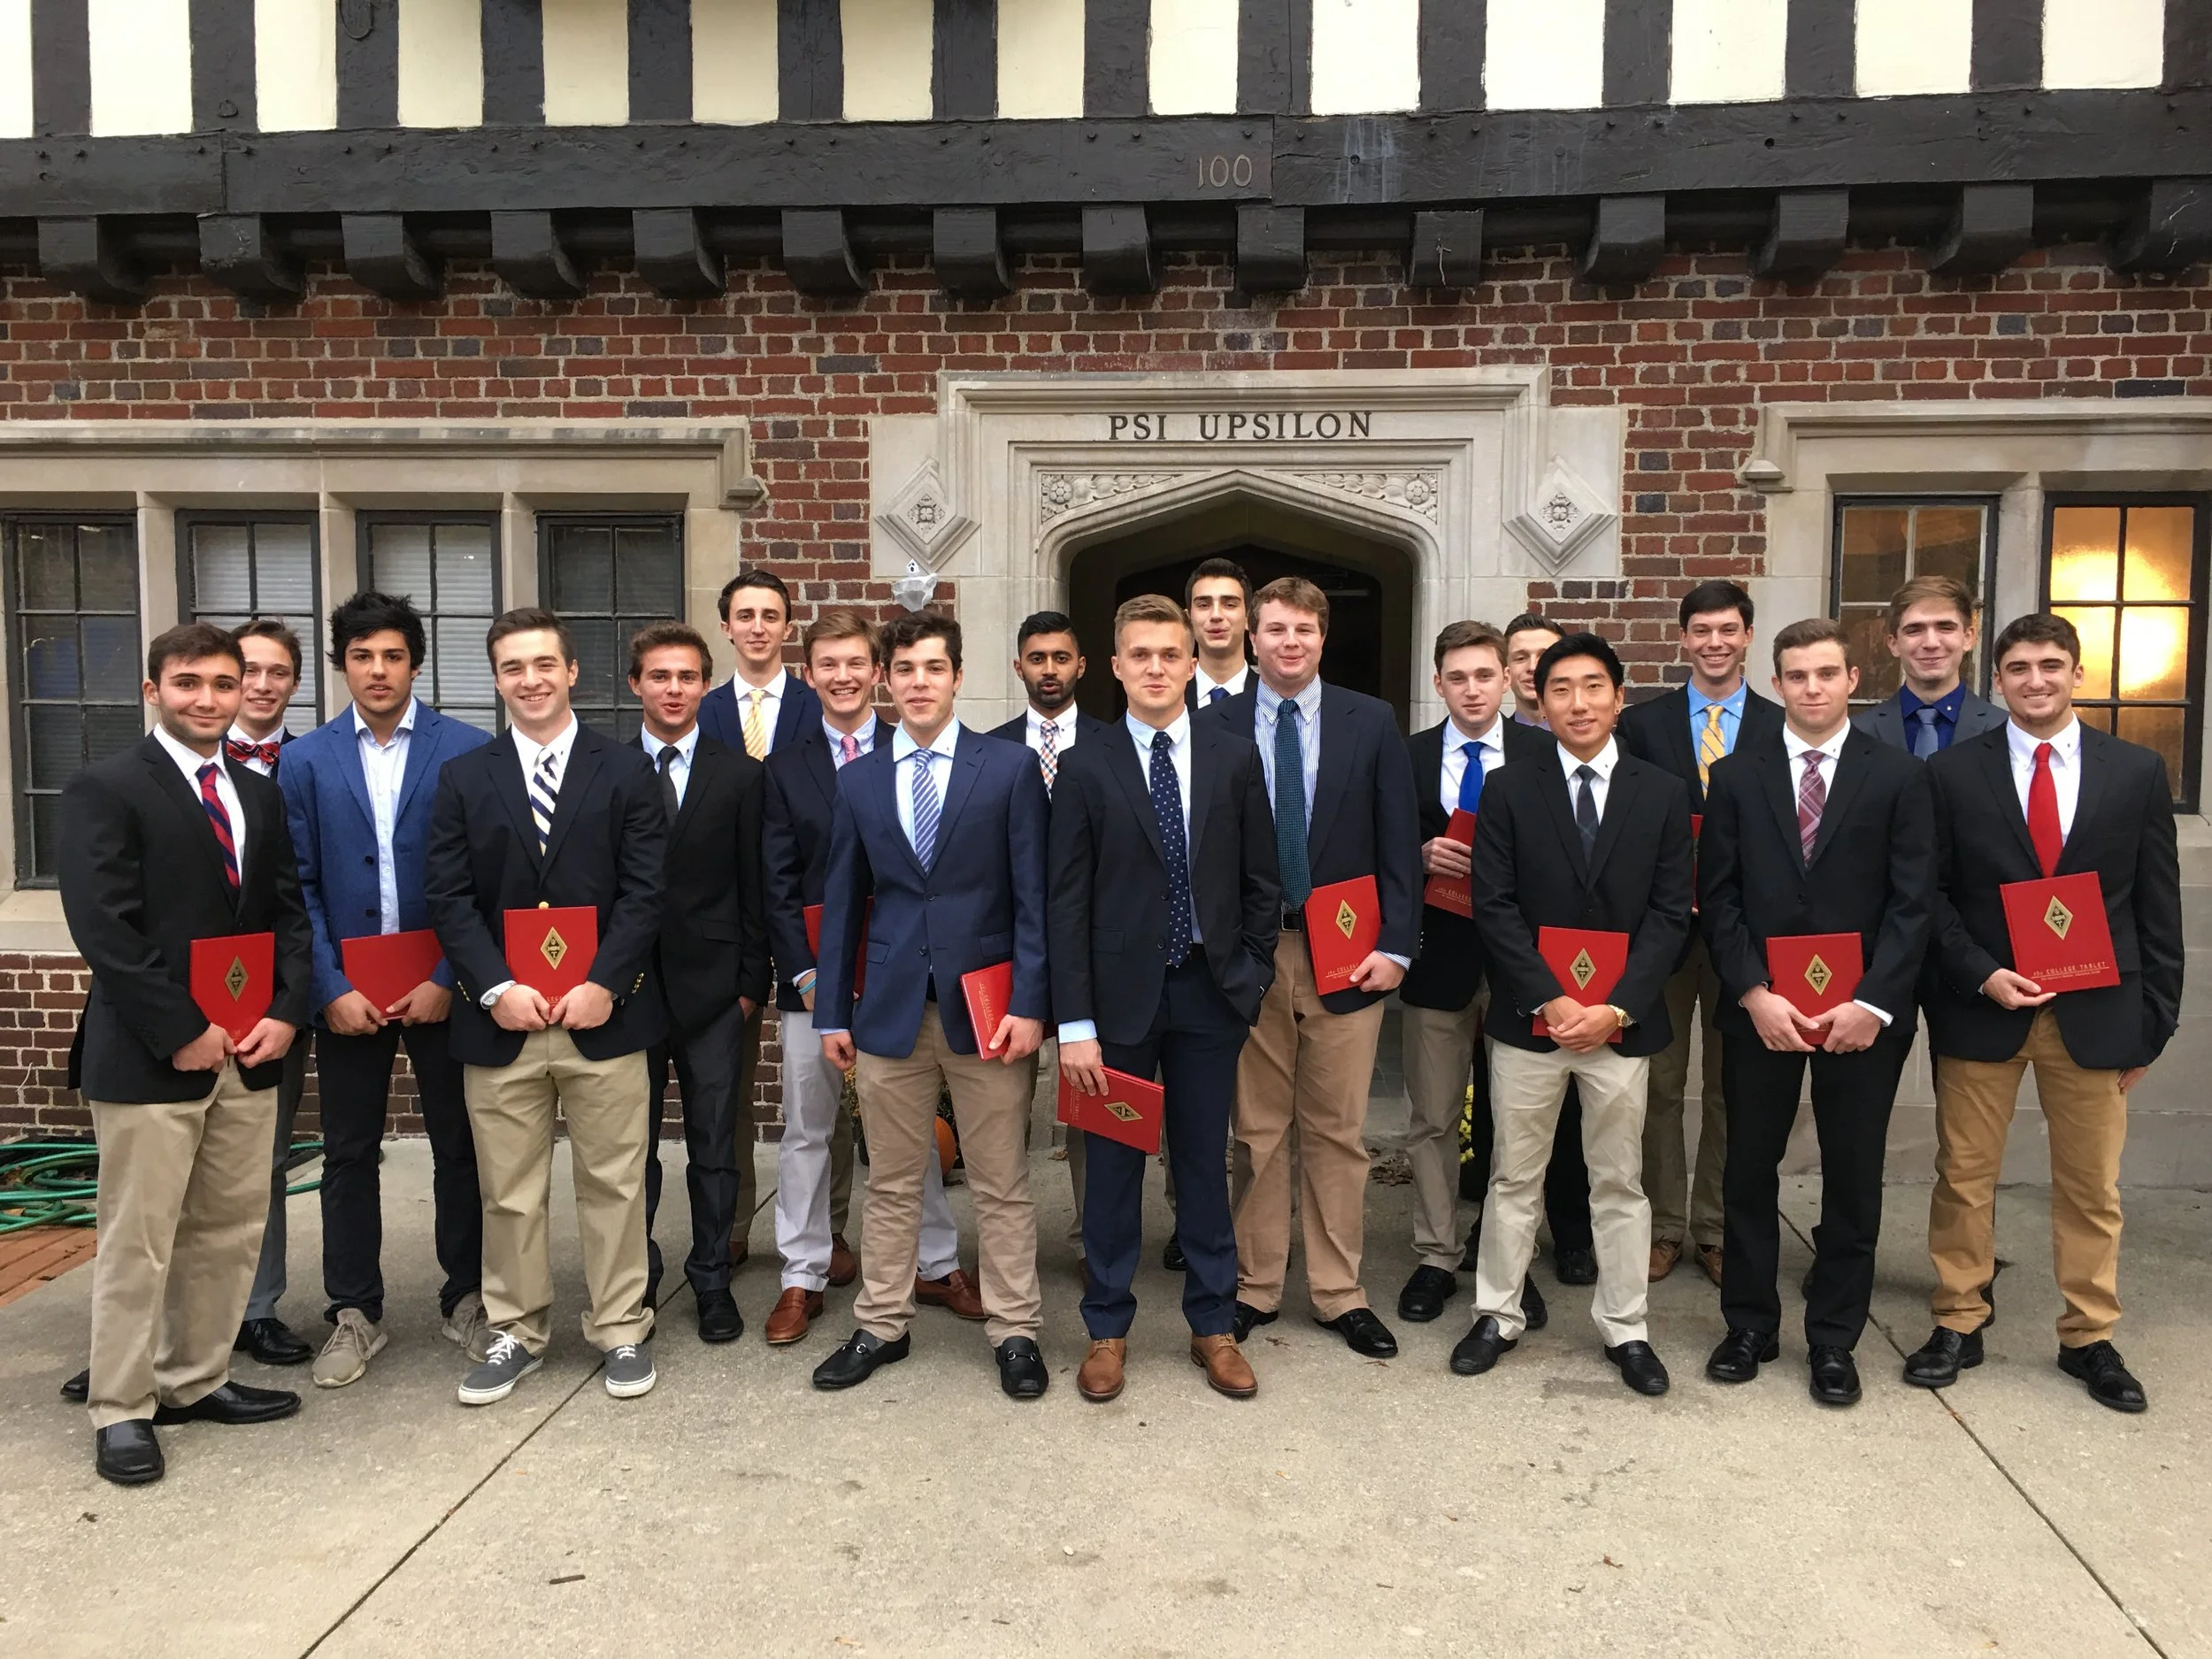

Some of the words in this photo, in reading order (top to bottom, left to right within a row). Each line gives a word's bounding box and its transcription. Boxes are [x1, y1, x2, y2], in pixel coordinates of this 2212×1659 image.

[1198, 154, 1252, 188] 100
[1108, 413, 1167, 441] PSI
[1198, 411, 1372, 441] UPSILON
[2046, 964, 2077, 975] COLLEGE
